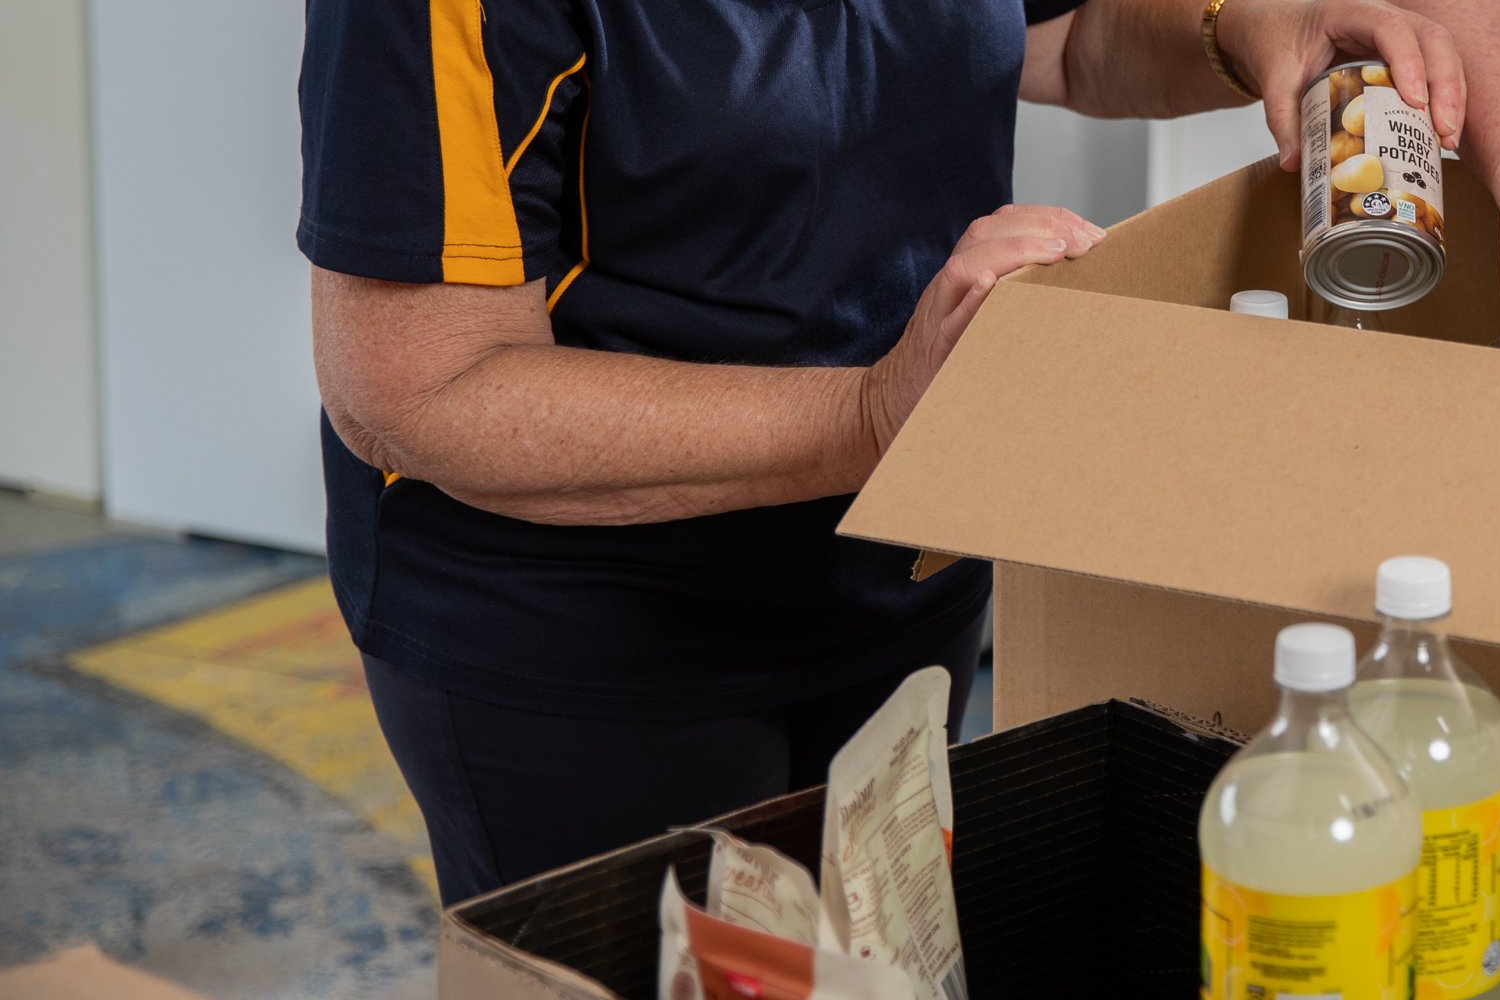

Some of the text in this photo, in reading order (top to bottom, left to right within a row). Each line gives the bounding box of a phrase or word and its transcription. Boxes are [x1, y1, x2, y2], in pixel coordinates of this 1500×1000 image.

[1388, 120, 1433, 151] WHOLE
[1398, 135, 1430, 159] BABY
[1379, 145, 1440, 184] POTATOES
